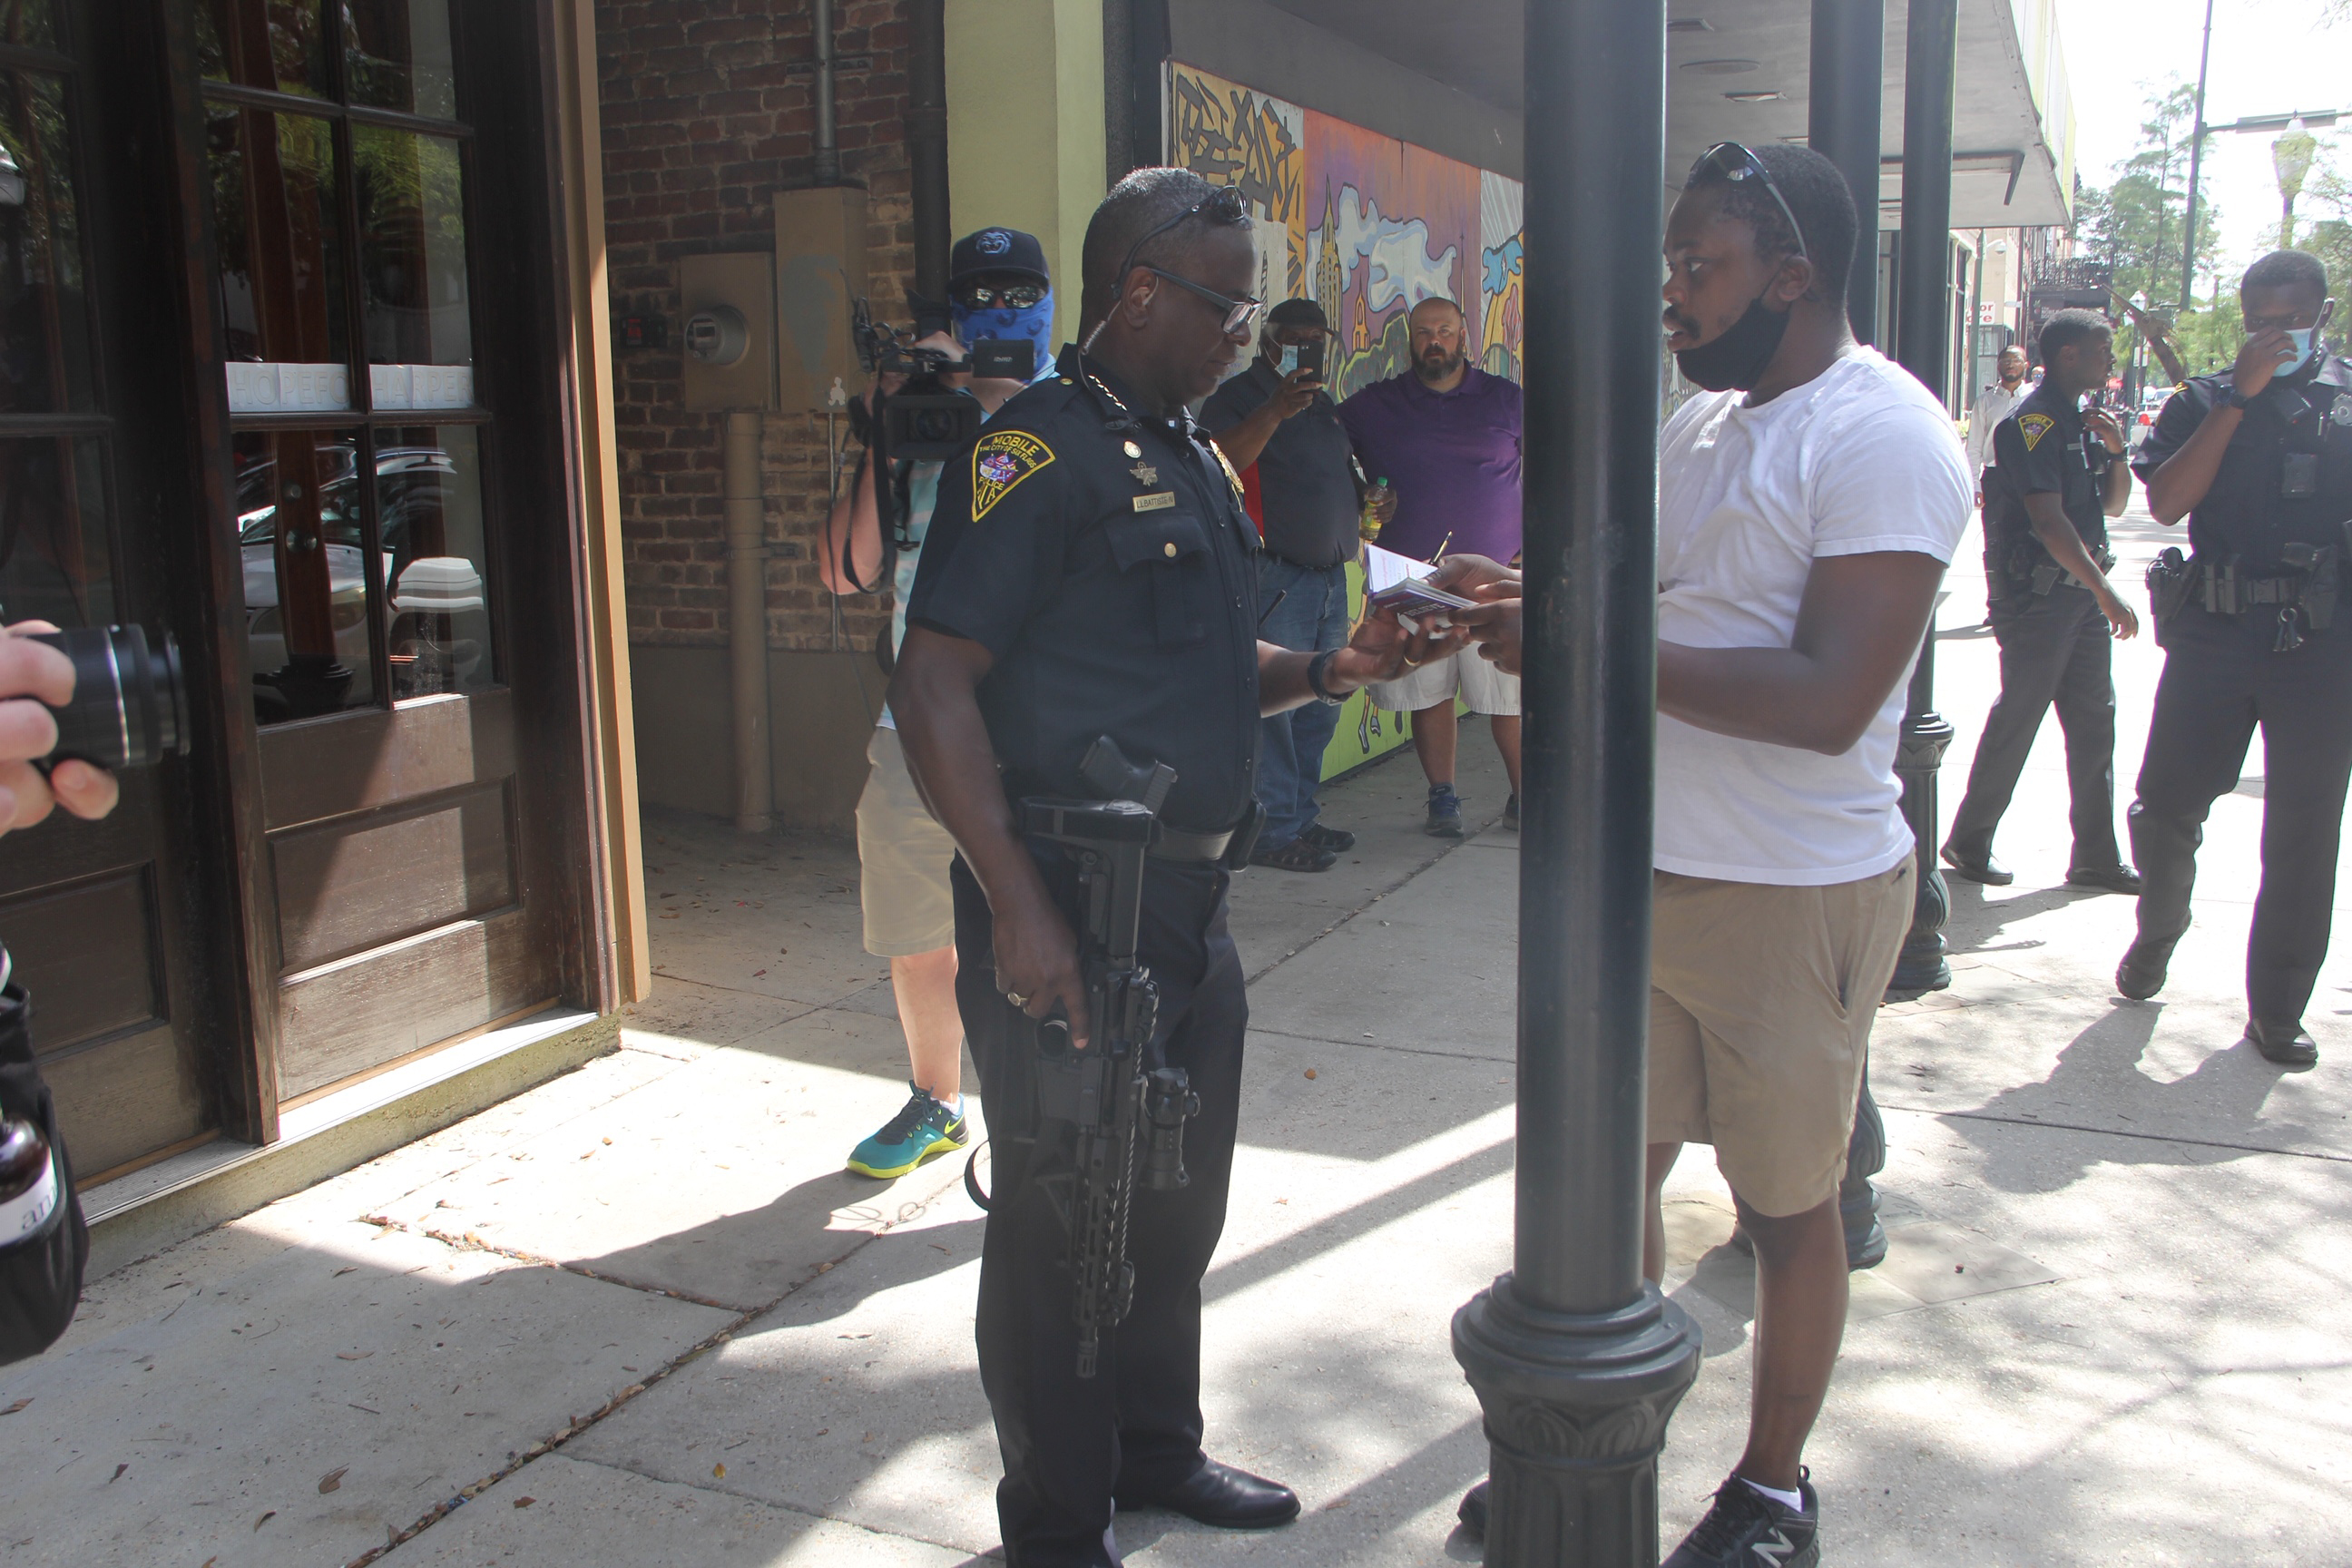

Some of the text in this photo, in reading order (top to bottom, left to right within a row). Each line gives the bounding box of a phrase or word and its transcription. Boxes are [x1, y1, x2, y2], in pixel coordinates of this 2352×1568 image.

[372, 370, 473, 404] HARPER
[993, 436, 1040, 456] MOBILE
[1003, 445, 1012, 454] OF
[1011, 447, 1022, 456] SIX
[1019, 452, 1037, 469] FLAGS
[979, 476, 1004, 490] POLICE
